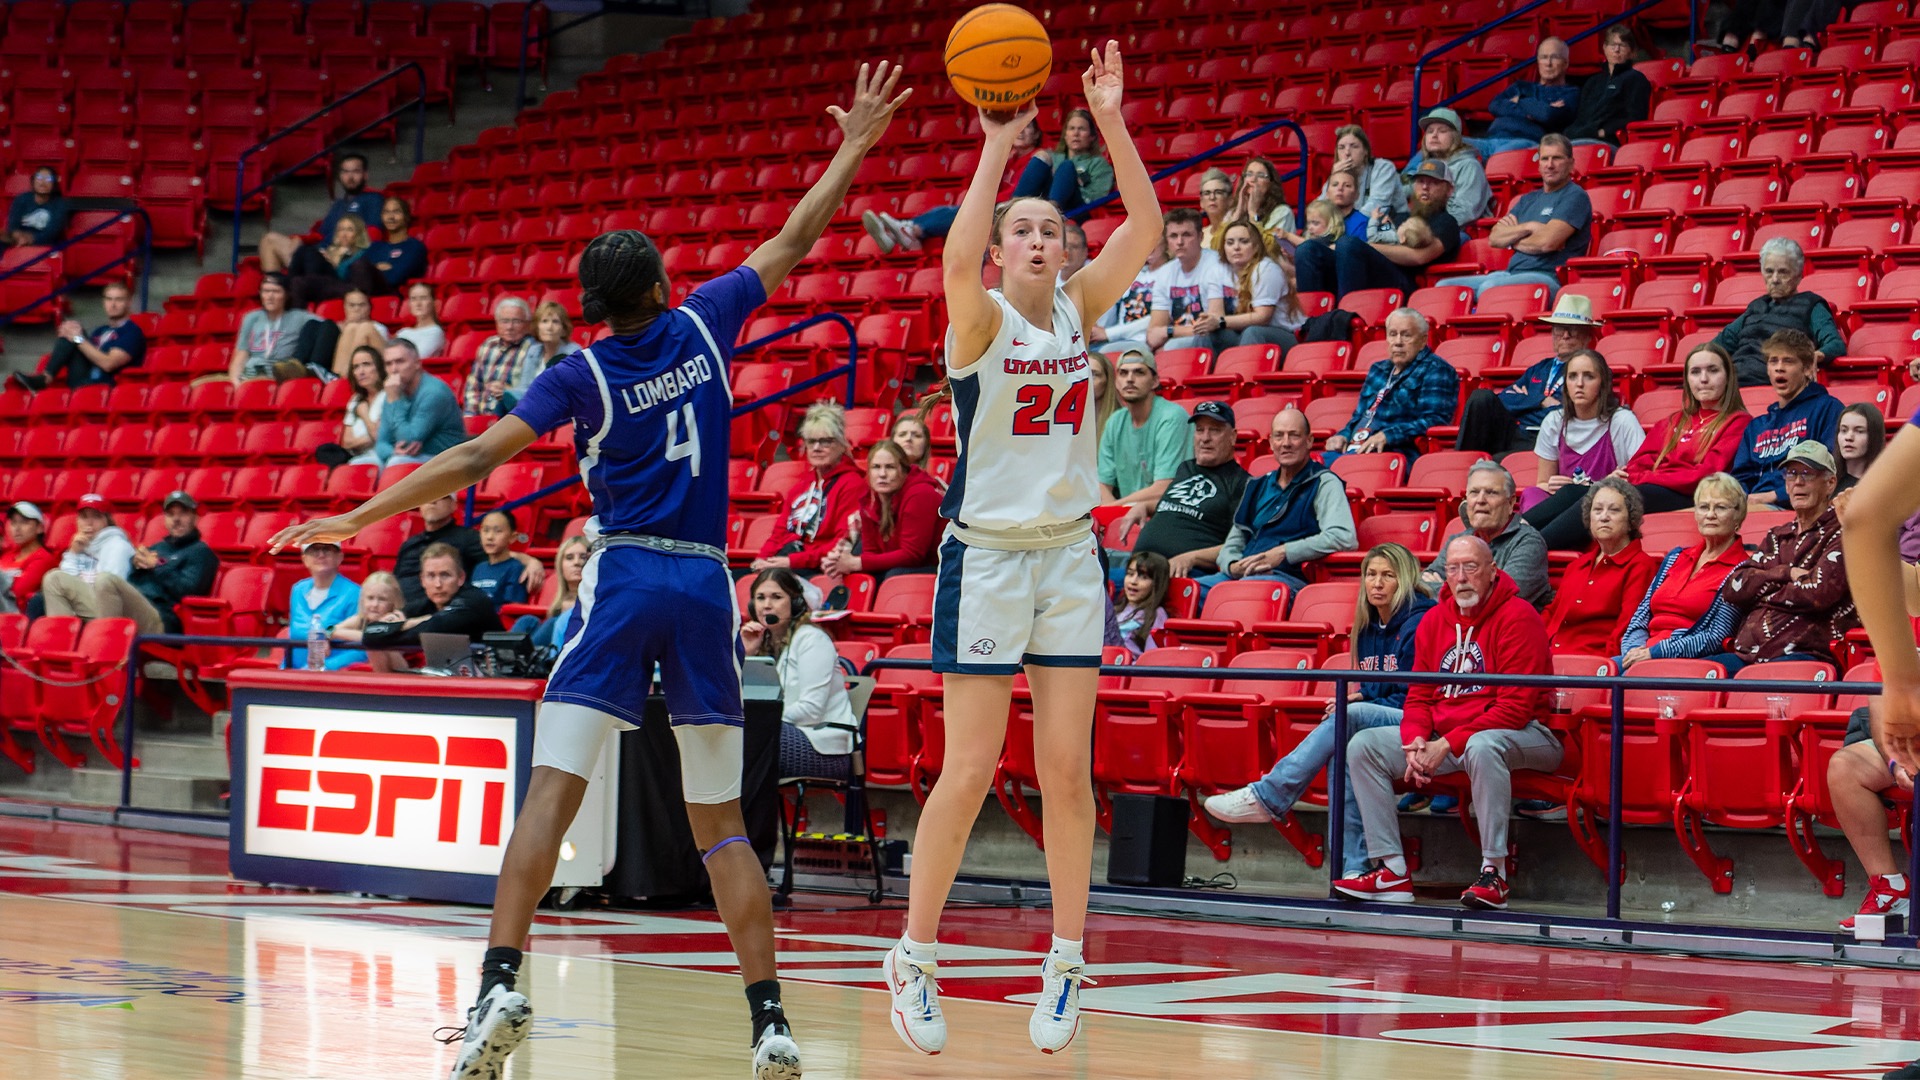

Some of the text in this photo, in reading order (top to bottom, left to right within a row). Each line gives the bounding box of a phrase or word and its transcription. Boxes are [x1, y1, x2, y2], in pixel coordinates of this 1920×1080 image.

[621, 353, 712, 414] LOMBARD
[1003, 358, 1058, 375] UTAH
[1012, 378, 1089, 436] 24
[665, 402, 701, 477] 4
[257, 727, 507, 846] ESPN
